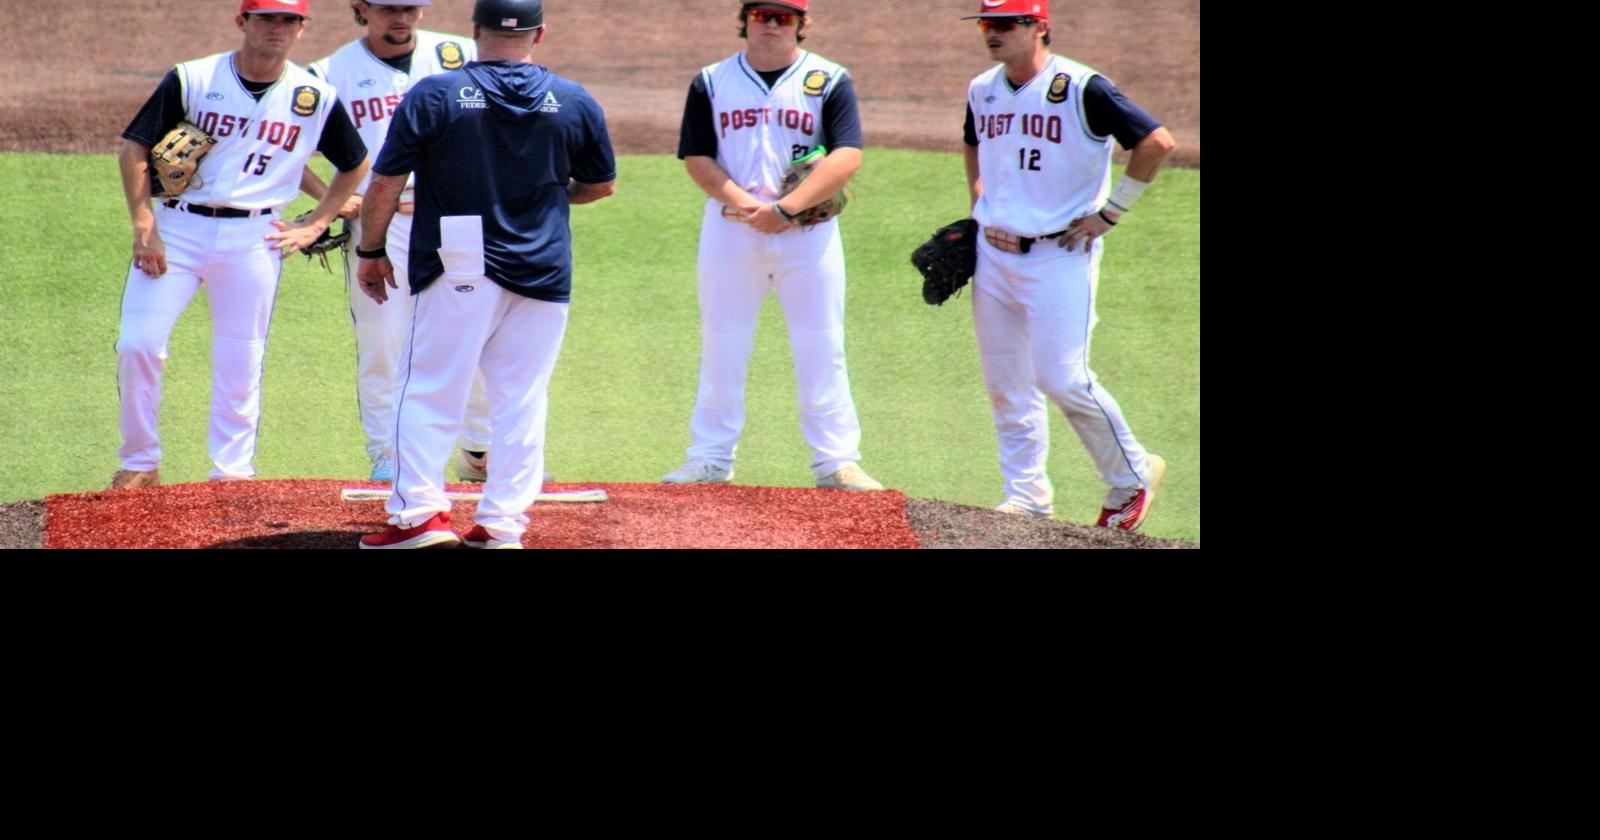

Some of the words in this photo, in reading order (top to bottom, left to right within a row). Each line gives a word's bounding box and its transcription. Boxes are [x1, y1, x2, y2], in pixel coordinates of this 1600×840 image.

[351, 93, 409, 129] POS
[719, 108, 771, 139] POST
[777, 108, 814, 136] 100
[256, 119, 301, 152] 100
[1021, 113, 1062, 144] 100
[242, 152, 272, 176] 15
[791, 144, 809, 160] 27
[1018, 147, 1041, 171] 12
